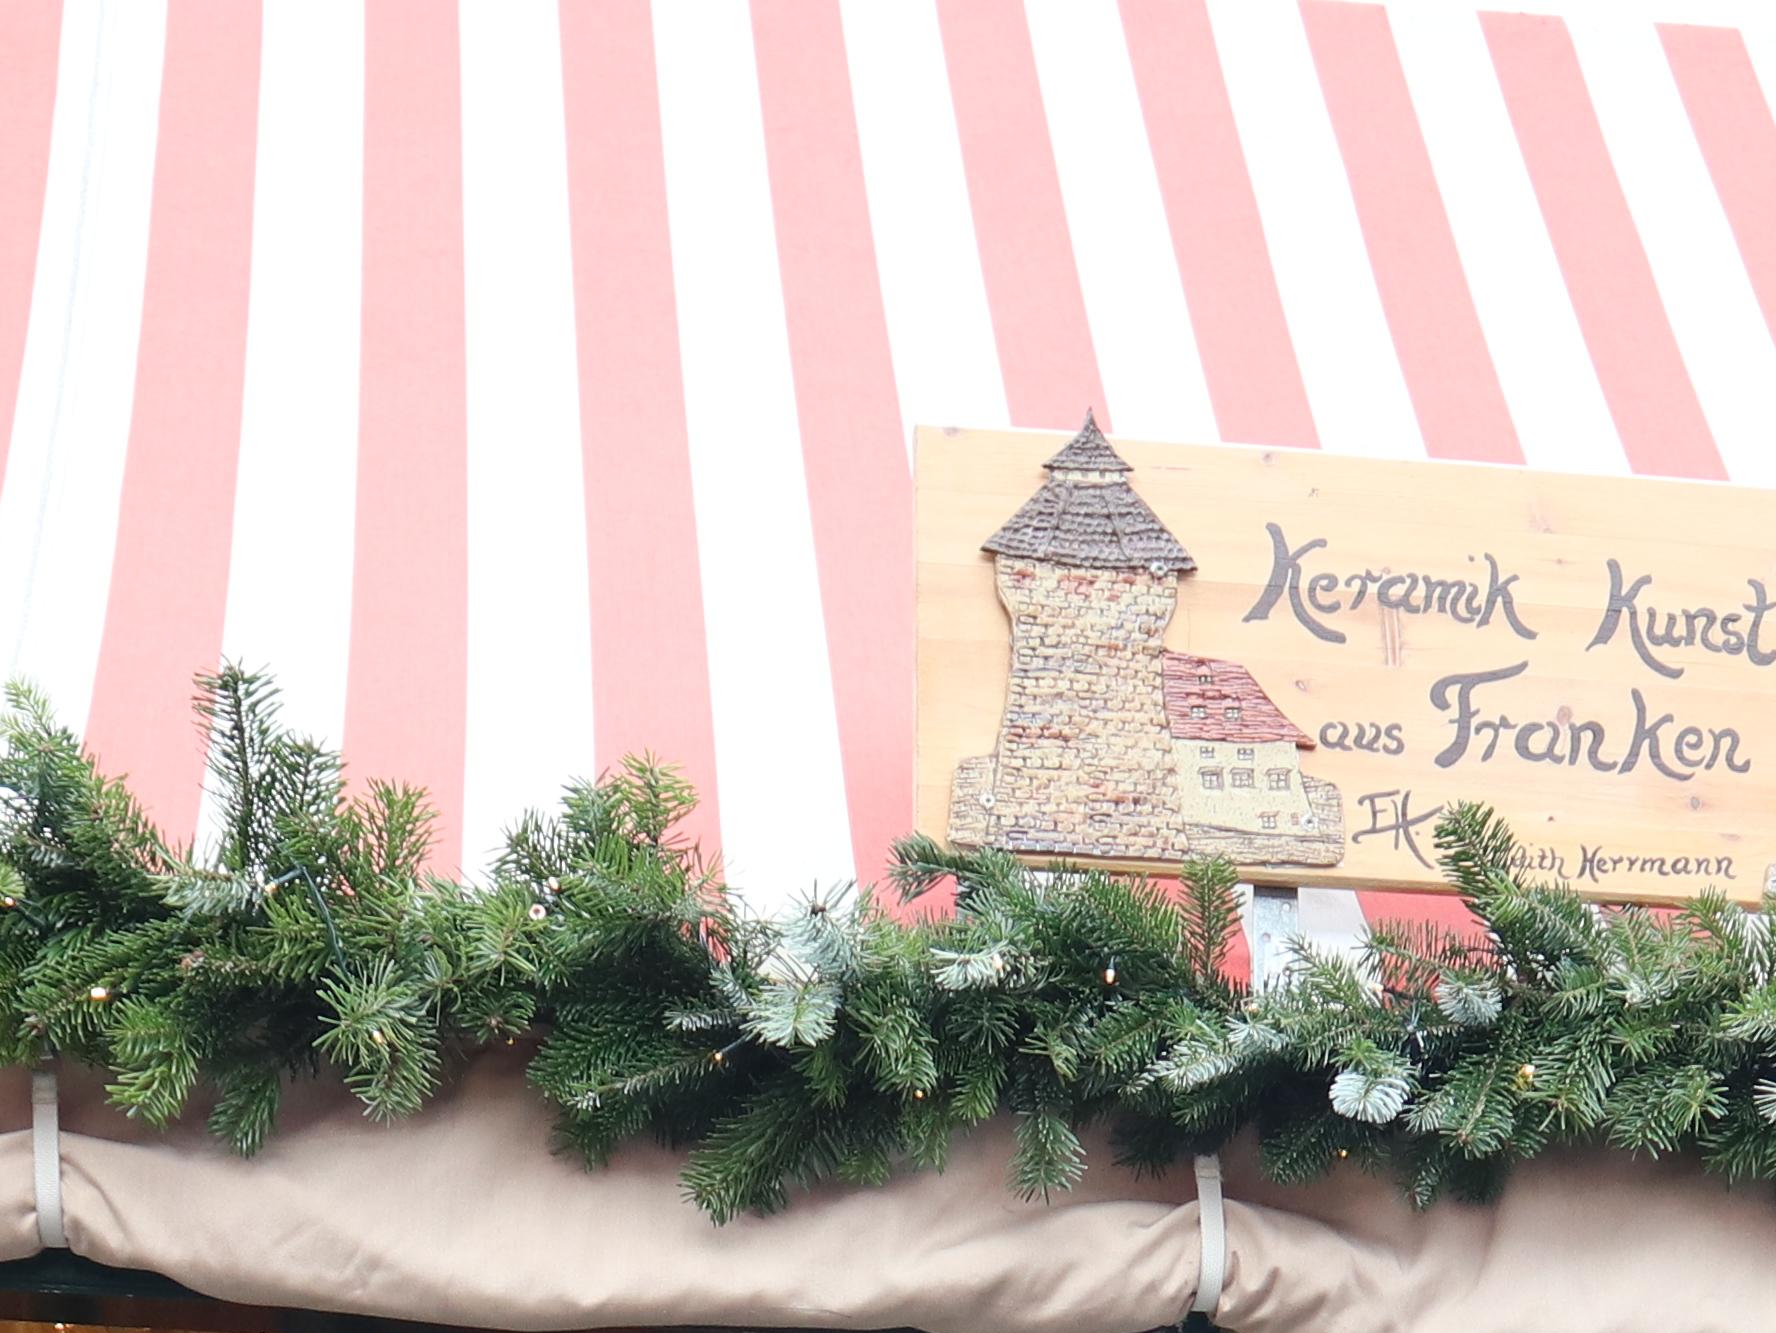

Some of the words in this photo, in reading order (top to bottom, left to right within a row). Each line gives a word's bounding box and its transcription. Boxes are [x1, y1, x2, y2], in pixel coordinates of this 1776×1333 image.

[1242, 521, 1539, 644] Keramik
[1318, 720, 1406, 755] aus
[1429, 659, 1752, 782] Franken
[1508, 842, 1574, 881] dith
[1576, 844, 1737, 883] Herrmann
